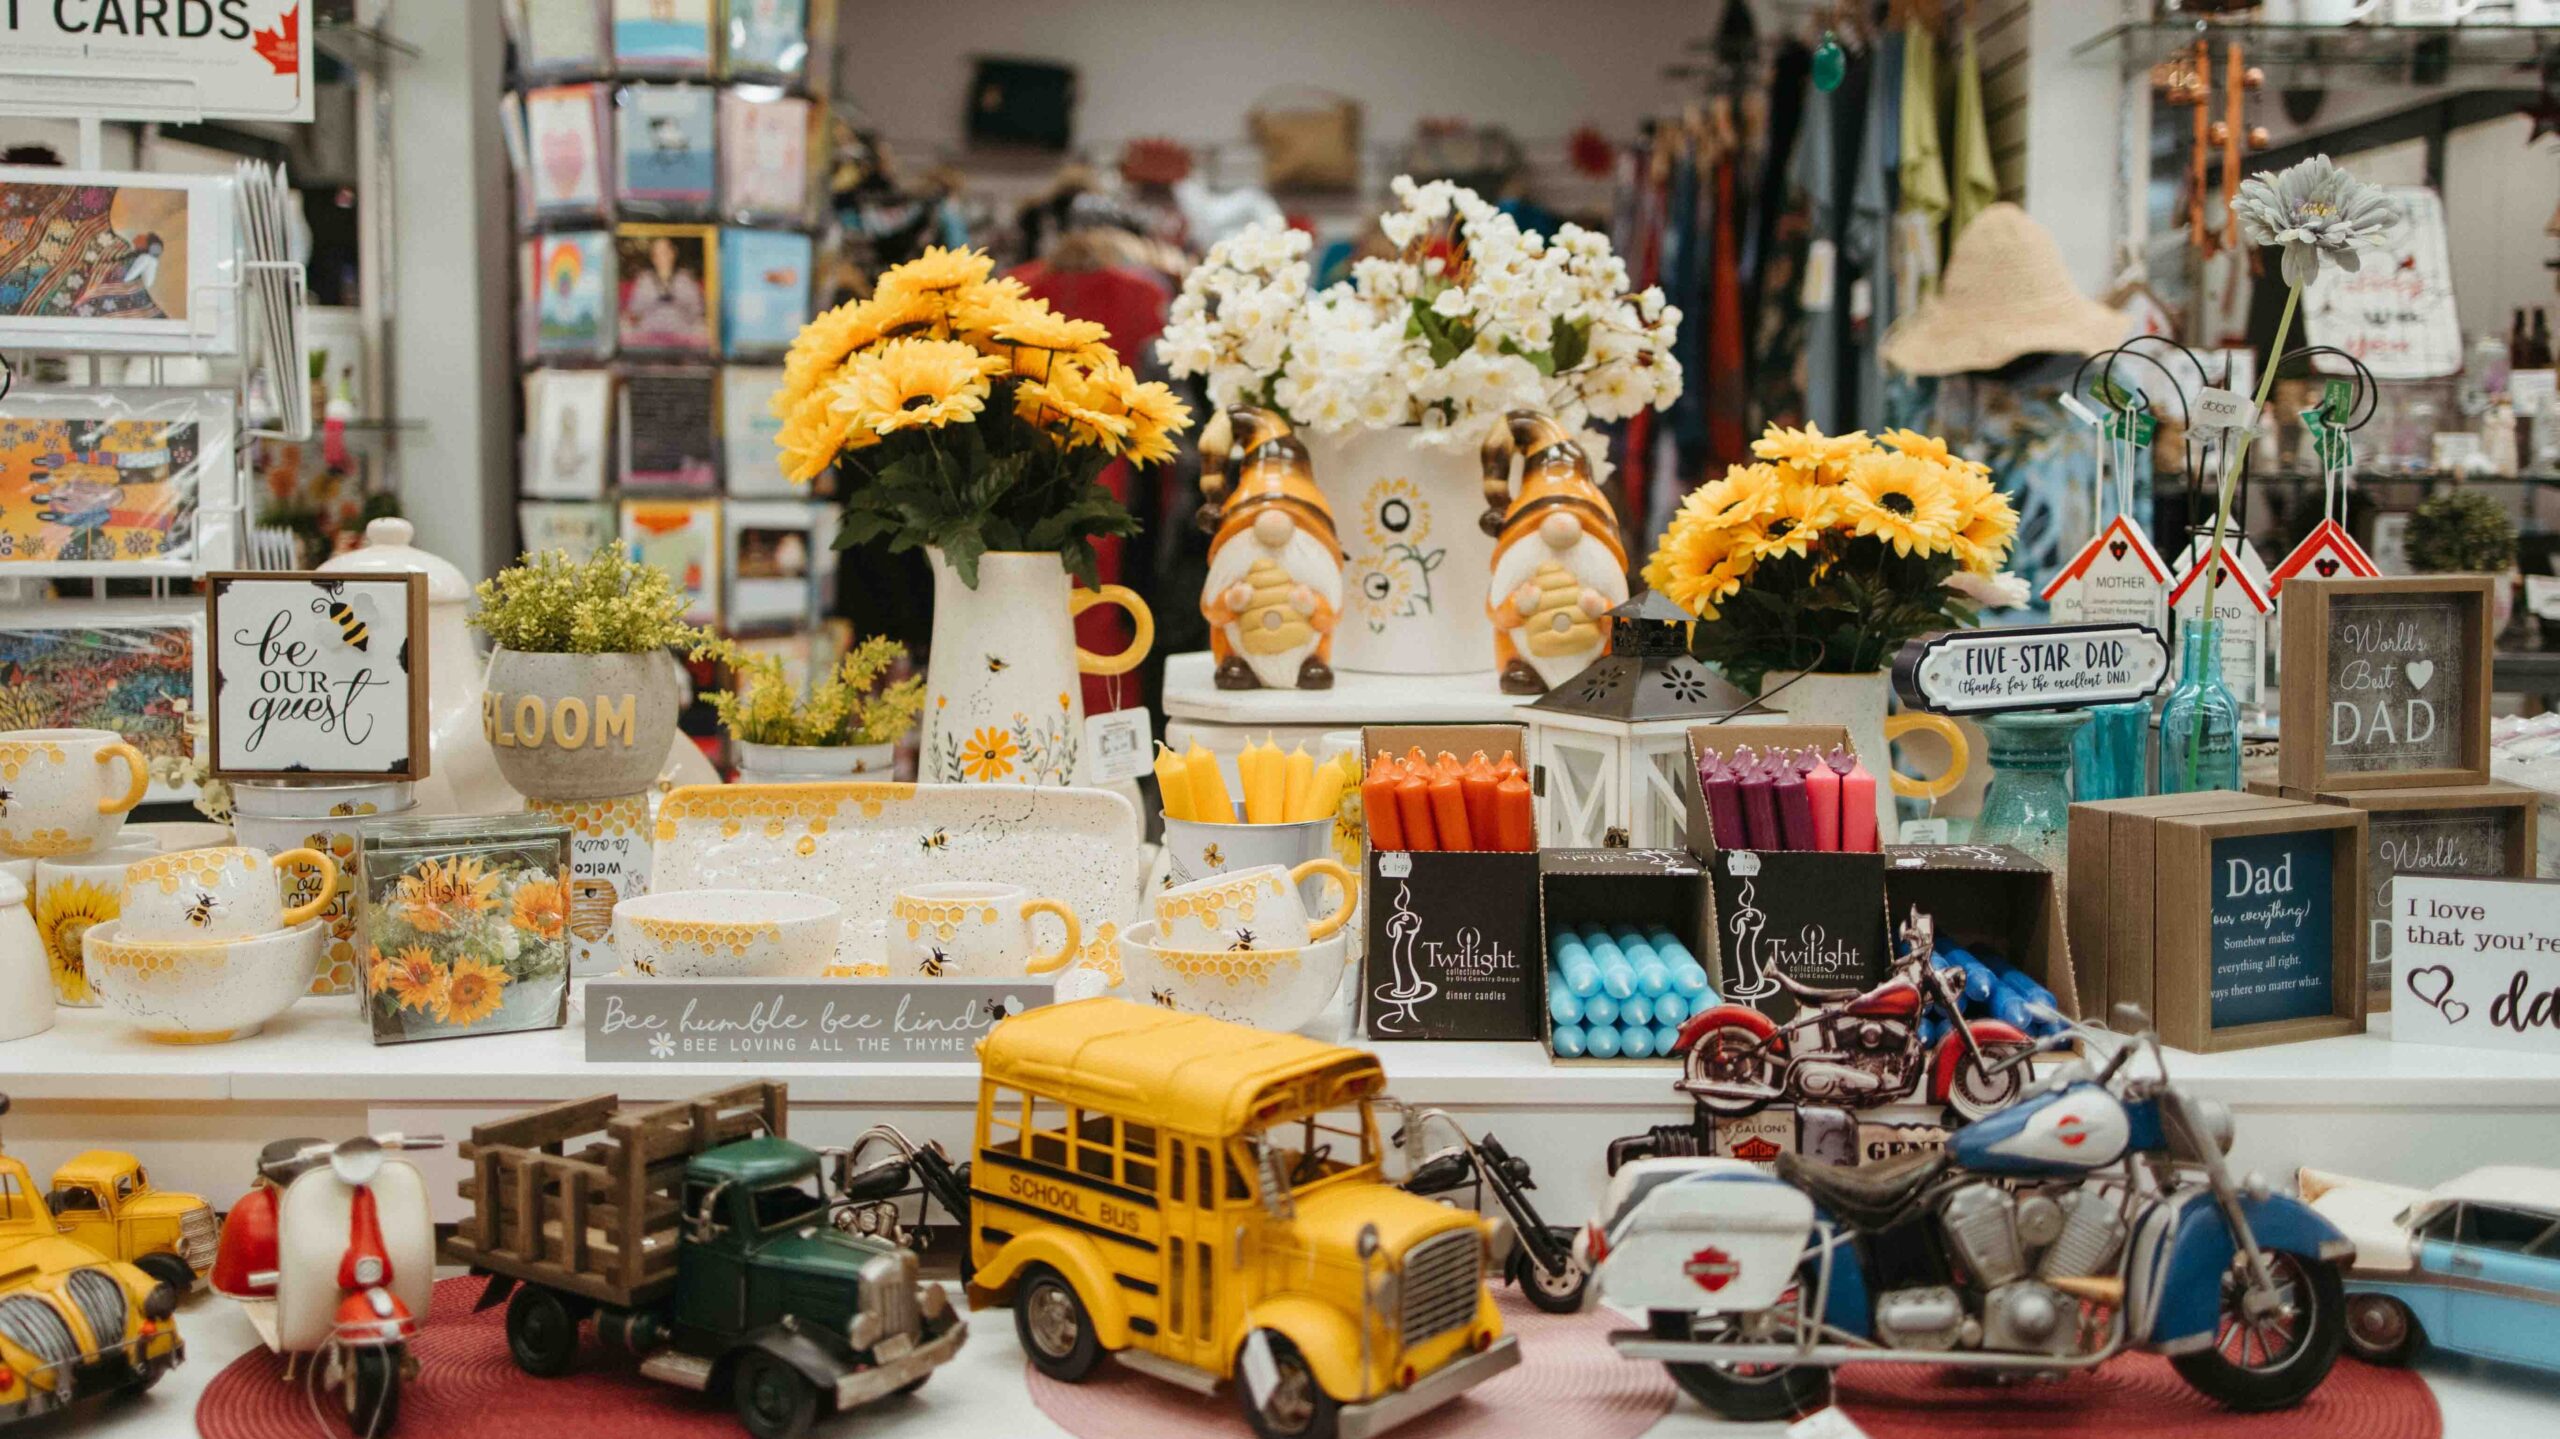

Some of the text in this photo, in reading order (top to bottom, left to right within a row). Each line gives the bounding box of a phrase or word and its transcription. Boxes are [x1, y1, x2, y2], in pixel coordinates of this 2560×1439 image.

[53, 0, 250, 40] CARDS
[2096, 576, 2146, 589] MOTHER
[2065, 597, 2083, 609] DA
[2195, 606, 2242, 620] FEND
[234, 609, 318, 667] be
[2343, 619, 2428, 653] World's
[1966, 640, 2125, 676] FIVE-STAR DAD
[260, 670, 329, 694] OUR
[1958, 669, 2131, 696] (thanks for the excellent DNA)
[2340, 659, 2398, 690] Best
[245, 668, 390, 752] guest
[482, 690, 637, 750] BLOOM
[2331, 699, 2436, 746] DAD
[612, 838, 630, 857] to
[2379, 835, 2469, 870] World's
[574, 862, 622, 876] Welco
[2226, 852, 2294, 898] Dad
[296, 877, 323, 892] ou
[2240, 899, 2311, 930] everything)
[2407, 898, 2486, 921] I love
[1765, 929, 1861, 973] Twilight
[2224, 931, 2296, 951] Somehow makes
[2407, 924, 2465, 947] that
[2474, 932, 2560, 953] you're
[1421, 931, 1517, 976] Twilight
[2217, 954, 2302, 976] everything all right.
[1446, 968, 1482, 977] collection
[2231, 981, 2253, 997] there
[2255, 983, 2267, 994] no
[2268, 978, 2297, 992] matter
[2298, 974, 2322, 988] what.
[1445, 990, 1507, 1001] dinner candles
[2489, 969, 2560, 1034] da
[600, 992, 991, 1035] Bee humble bee kind
[683, 1038, 718, 1052] BEE
[730, 1038, 797, 1052] LOVING
[809, 1038, 844, 1052] ALL
[857, 1037, 891, 1052] THE
[904, 1037, 966, 1051] THYME
[1735, 1123, 1788, 1134] GALLONS
[1009, 1173, 1140, 1233] SCHOOL BUS
